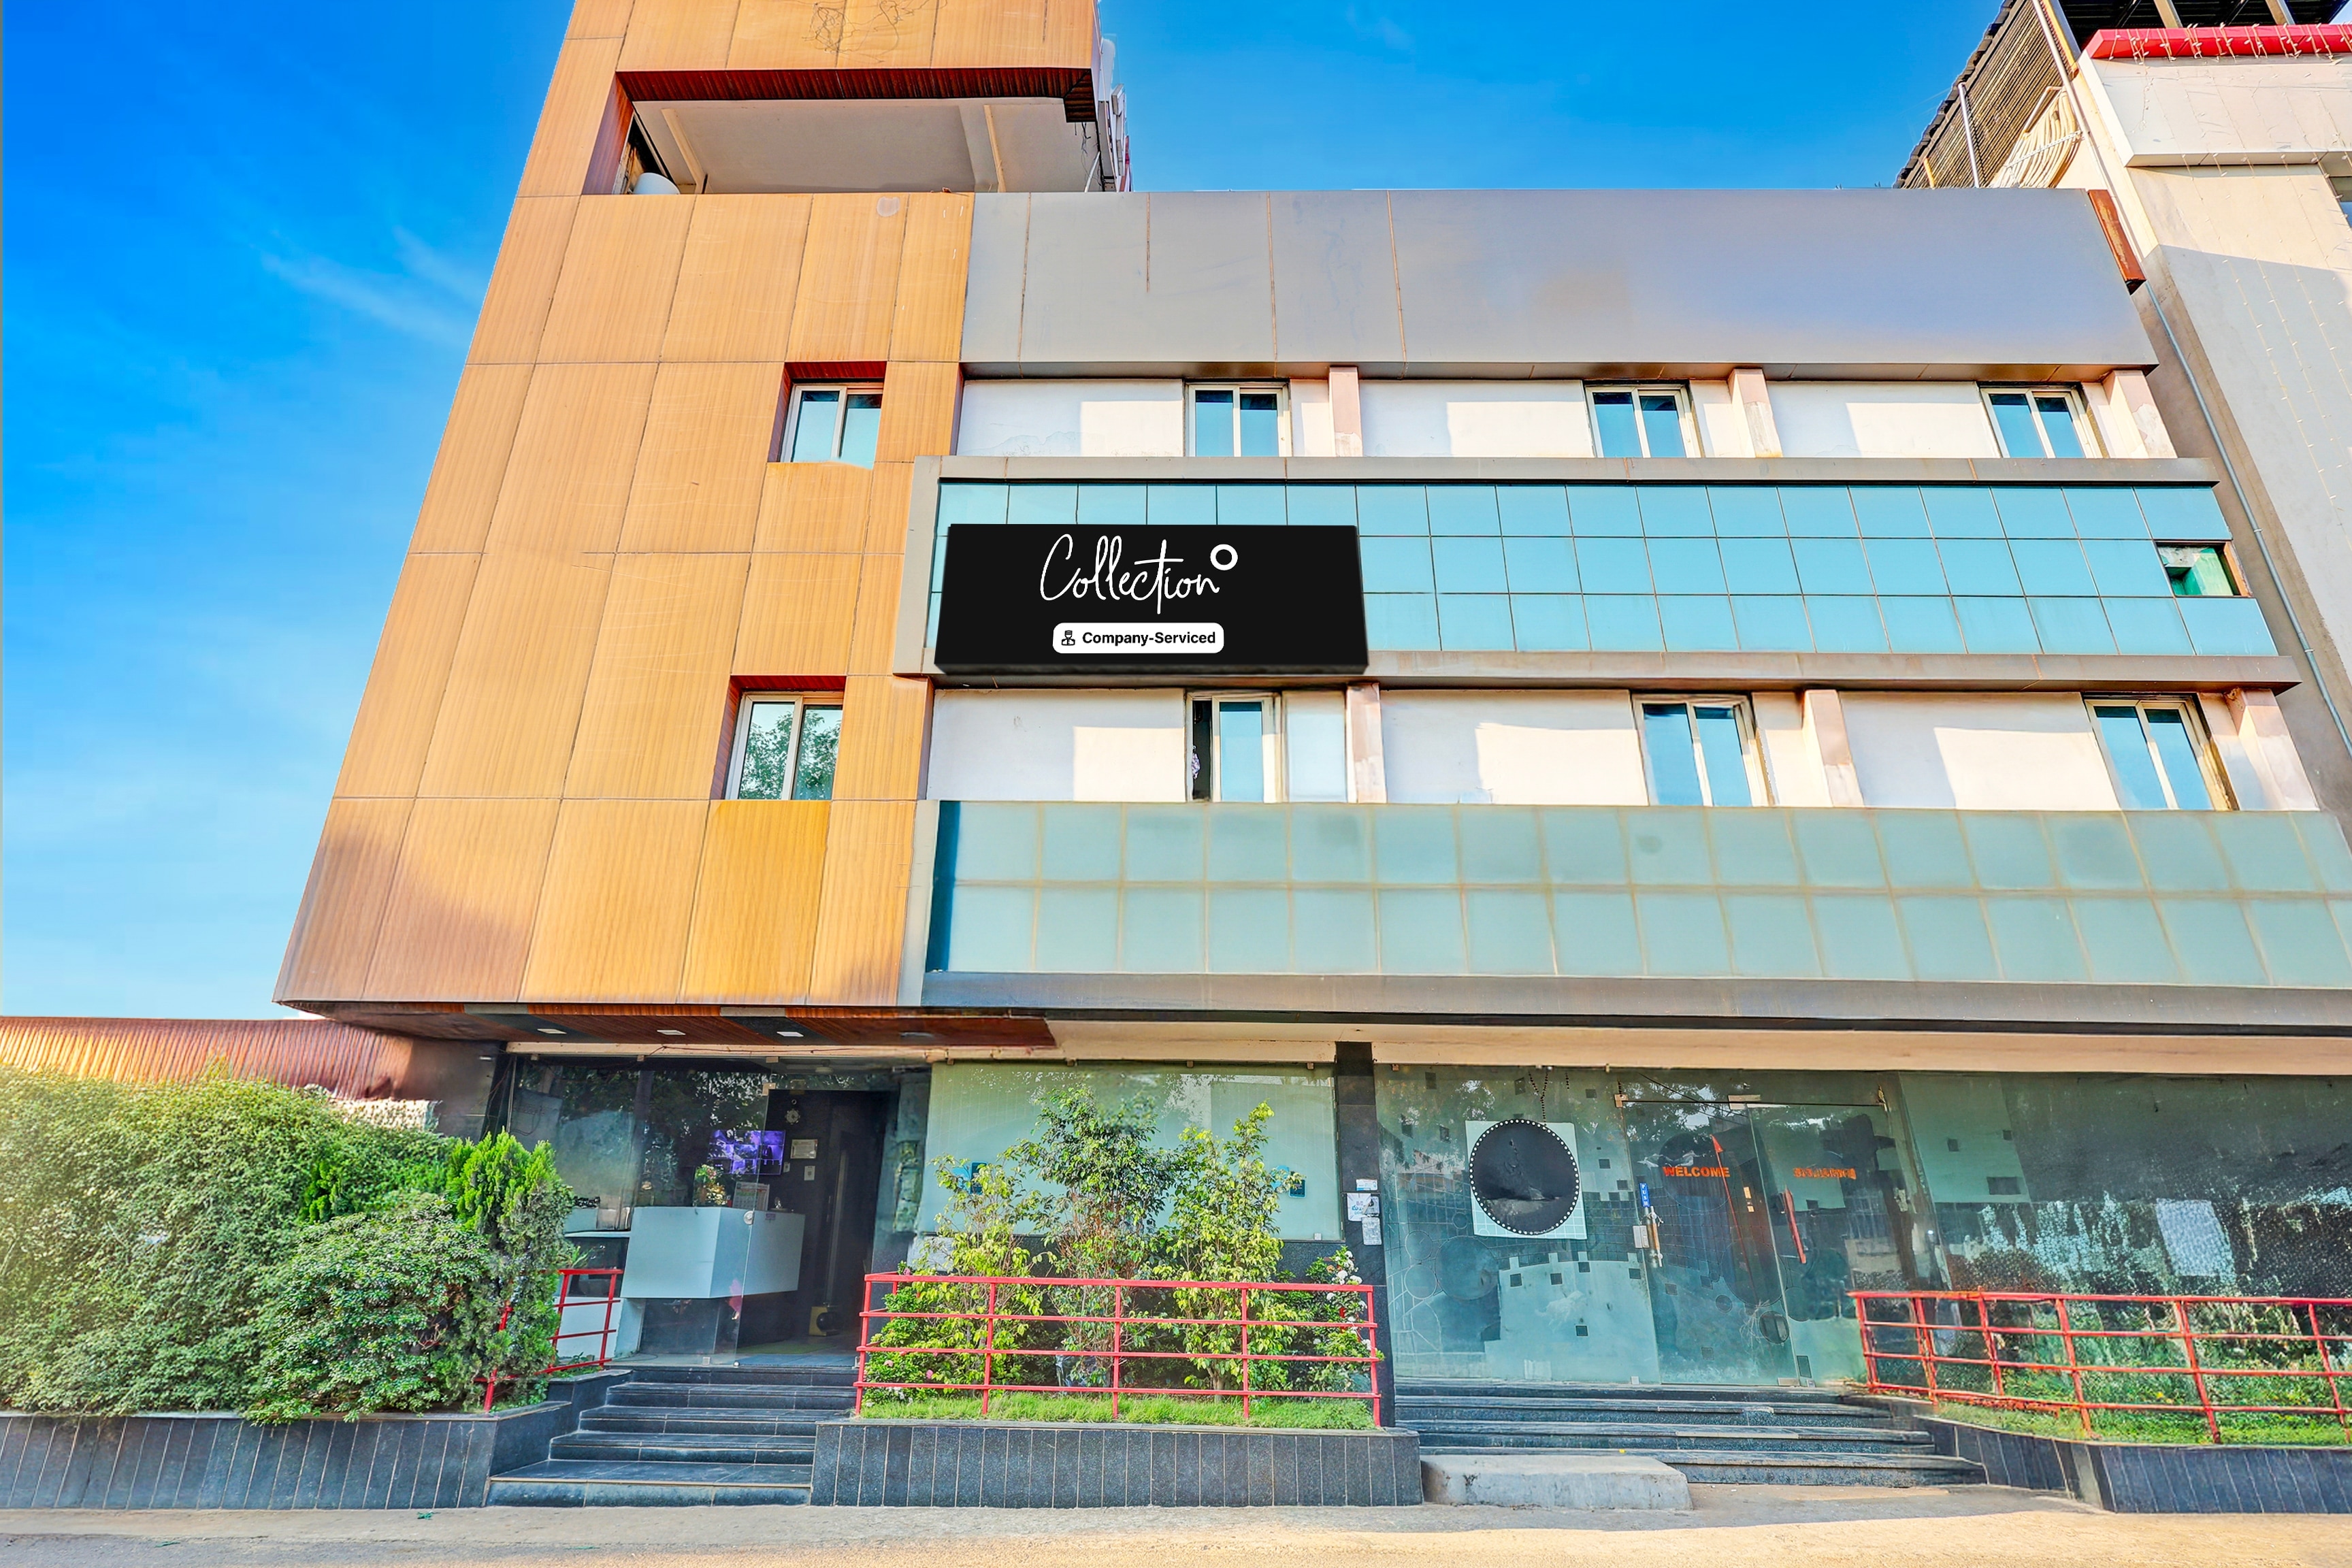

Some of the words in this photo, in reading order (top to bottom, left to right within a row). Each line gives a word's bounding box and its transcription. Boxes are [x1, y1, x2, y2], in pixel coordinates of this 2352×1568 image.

[1039, 534, 1220, 615] Collection
[1082, 631, 1215, 647] Company-Serviced
[1663, 1166, 1731, 1177] WELCOME
